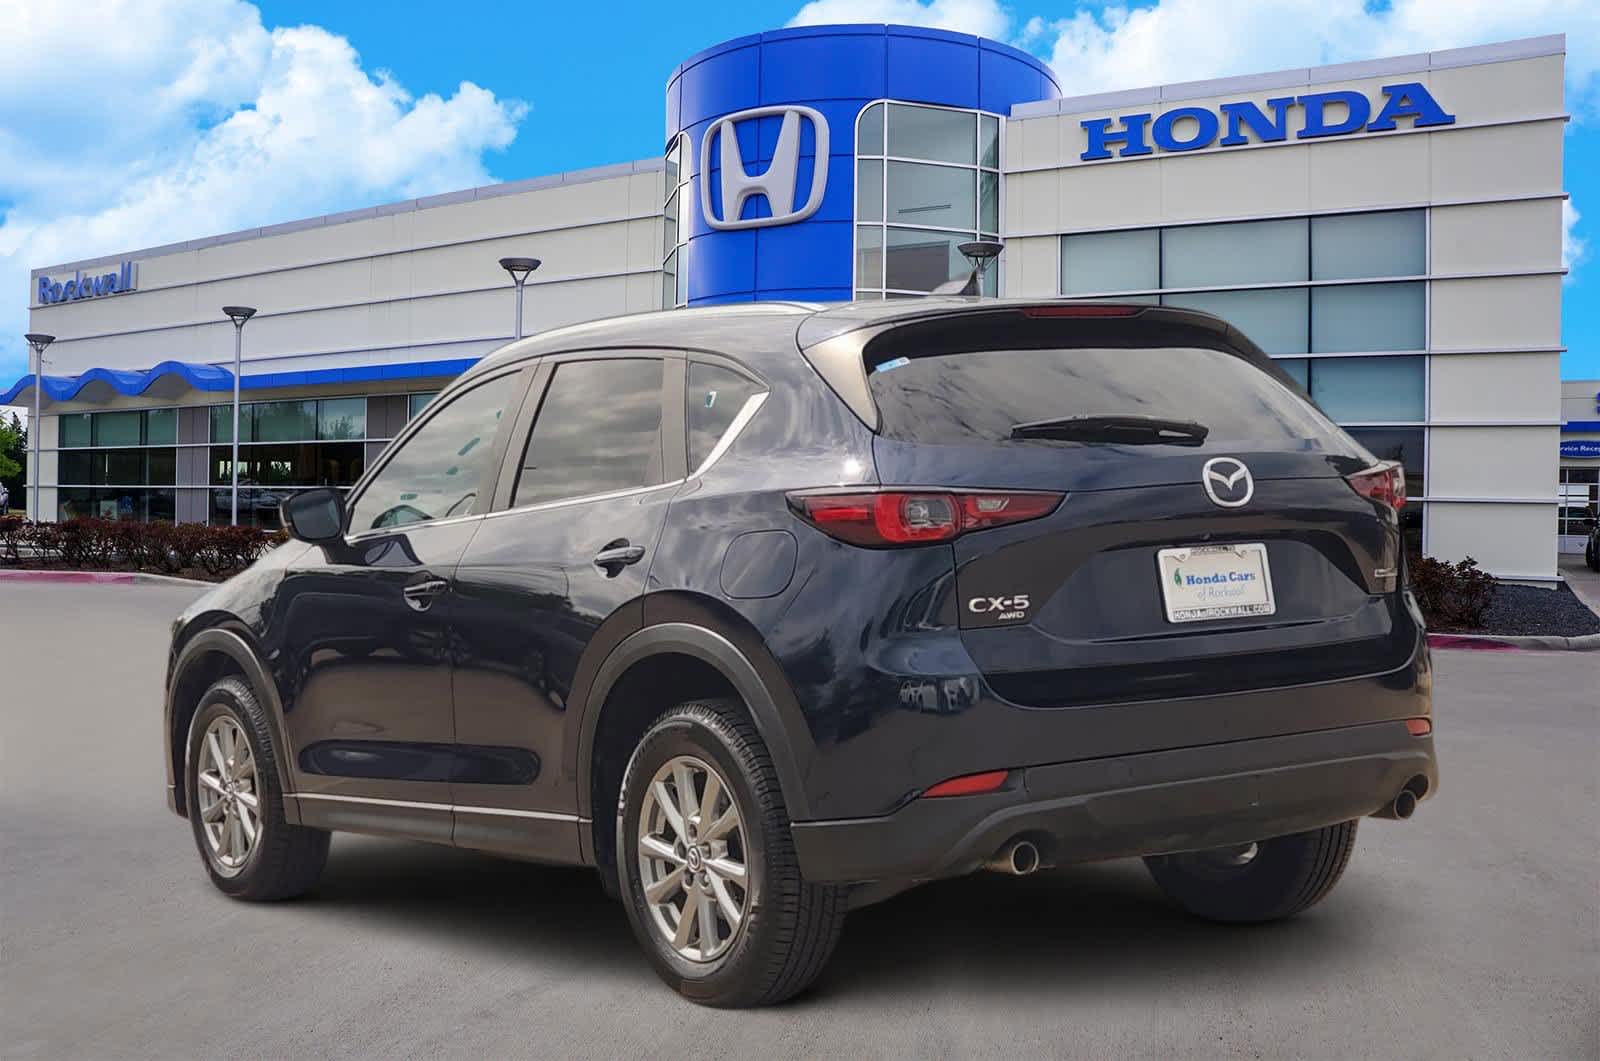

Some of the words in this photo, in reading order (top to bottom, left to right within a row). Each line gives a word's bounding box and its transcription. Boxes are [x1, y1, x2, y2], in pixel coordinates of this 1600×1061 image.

[1080, 82, 1456, 161] HONDA
[38, 261, 132, 304] Rockwall
[1186, 572, 1227, 585] Honda
[1229, 571, 1256, 582] Cars
[968, 595, 1029, 612] CX-5
[998, 611, 1025, 620] AWD
